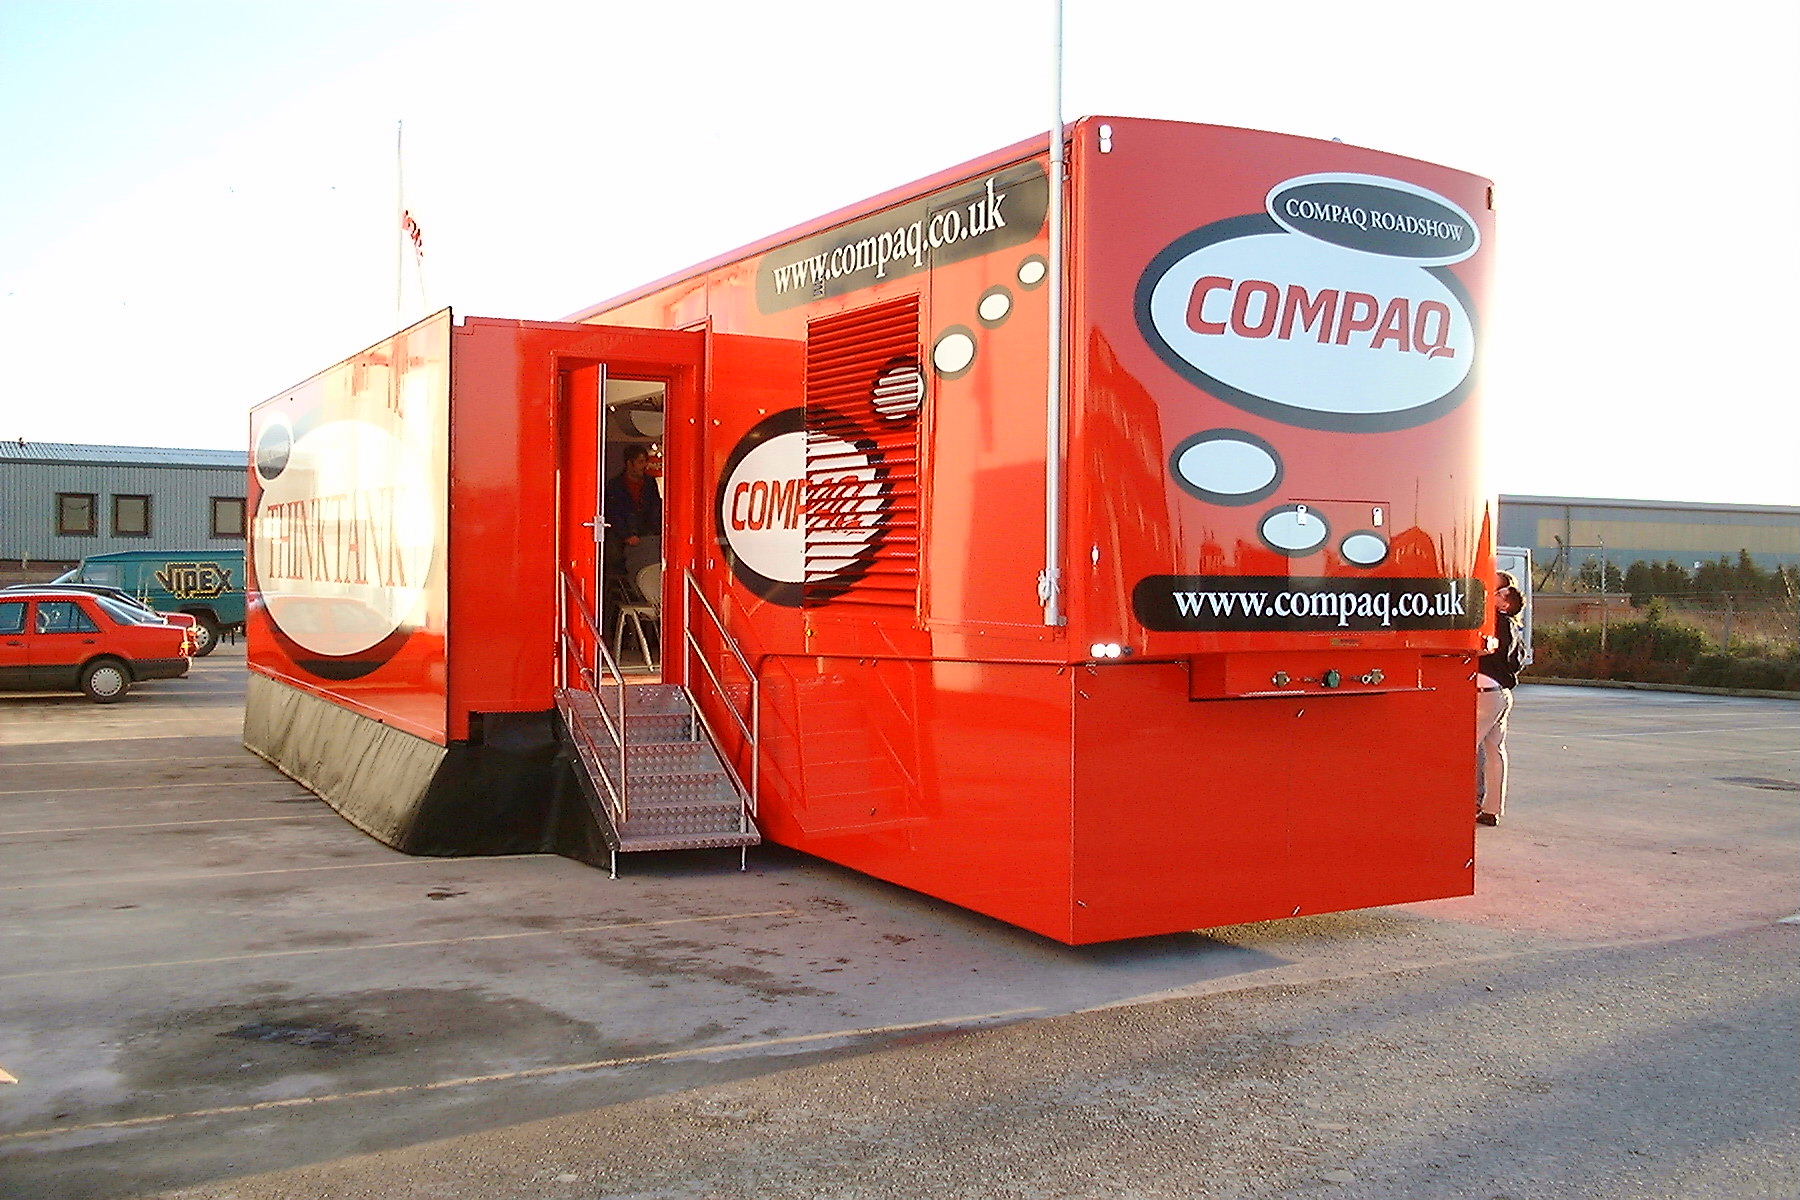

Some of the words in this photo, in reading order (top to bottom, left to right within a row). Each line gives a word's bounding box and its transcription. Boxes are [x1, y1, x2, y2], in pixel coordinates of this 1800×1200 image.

[772, 176, 1006, 295] www.compaq.co.uk
[1285, 198, 1369, 231] COMPAQ
[1370, 209, 1464, 242] ROADSHOW
[1186, 275, 1455, 359] COMPAQ
[1172, 581, 1465, 627] www.compaq.co.uk
